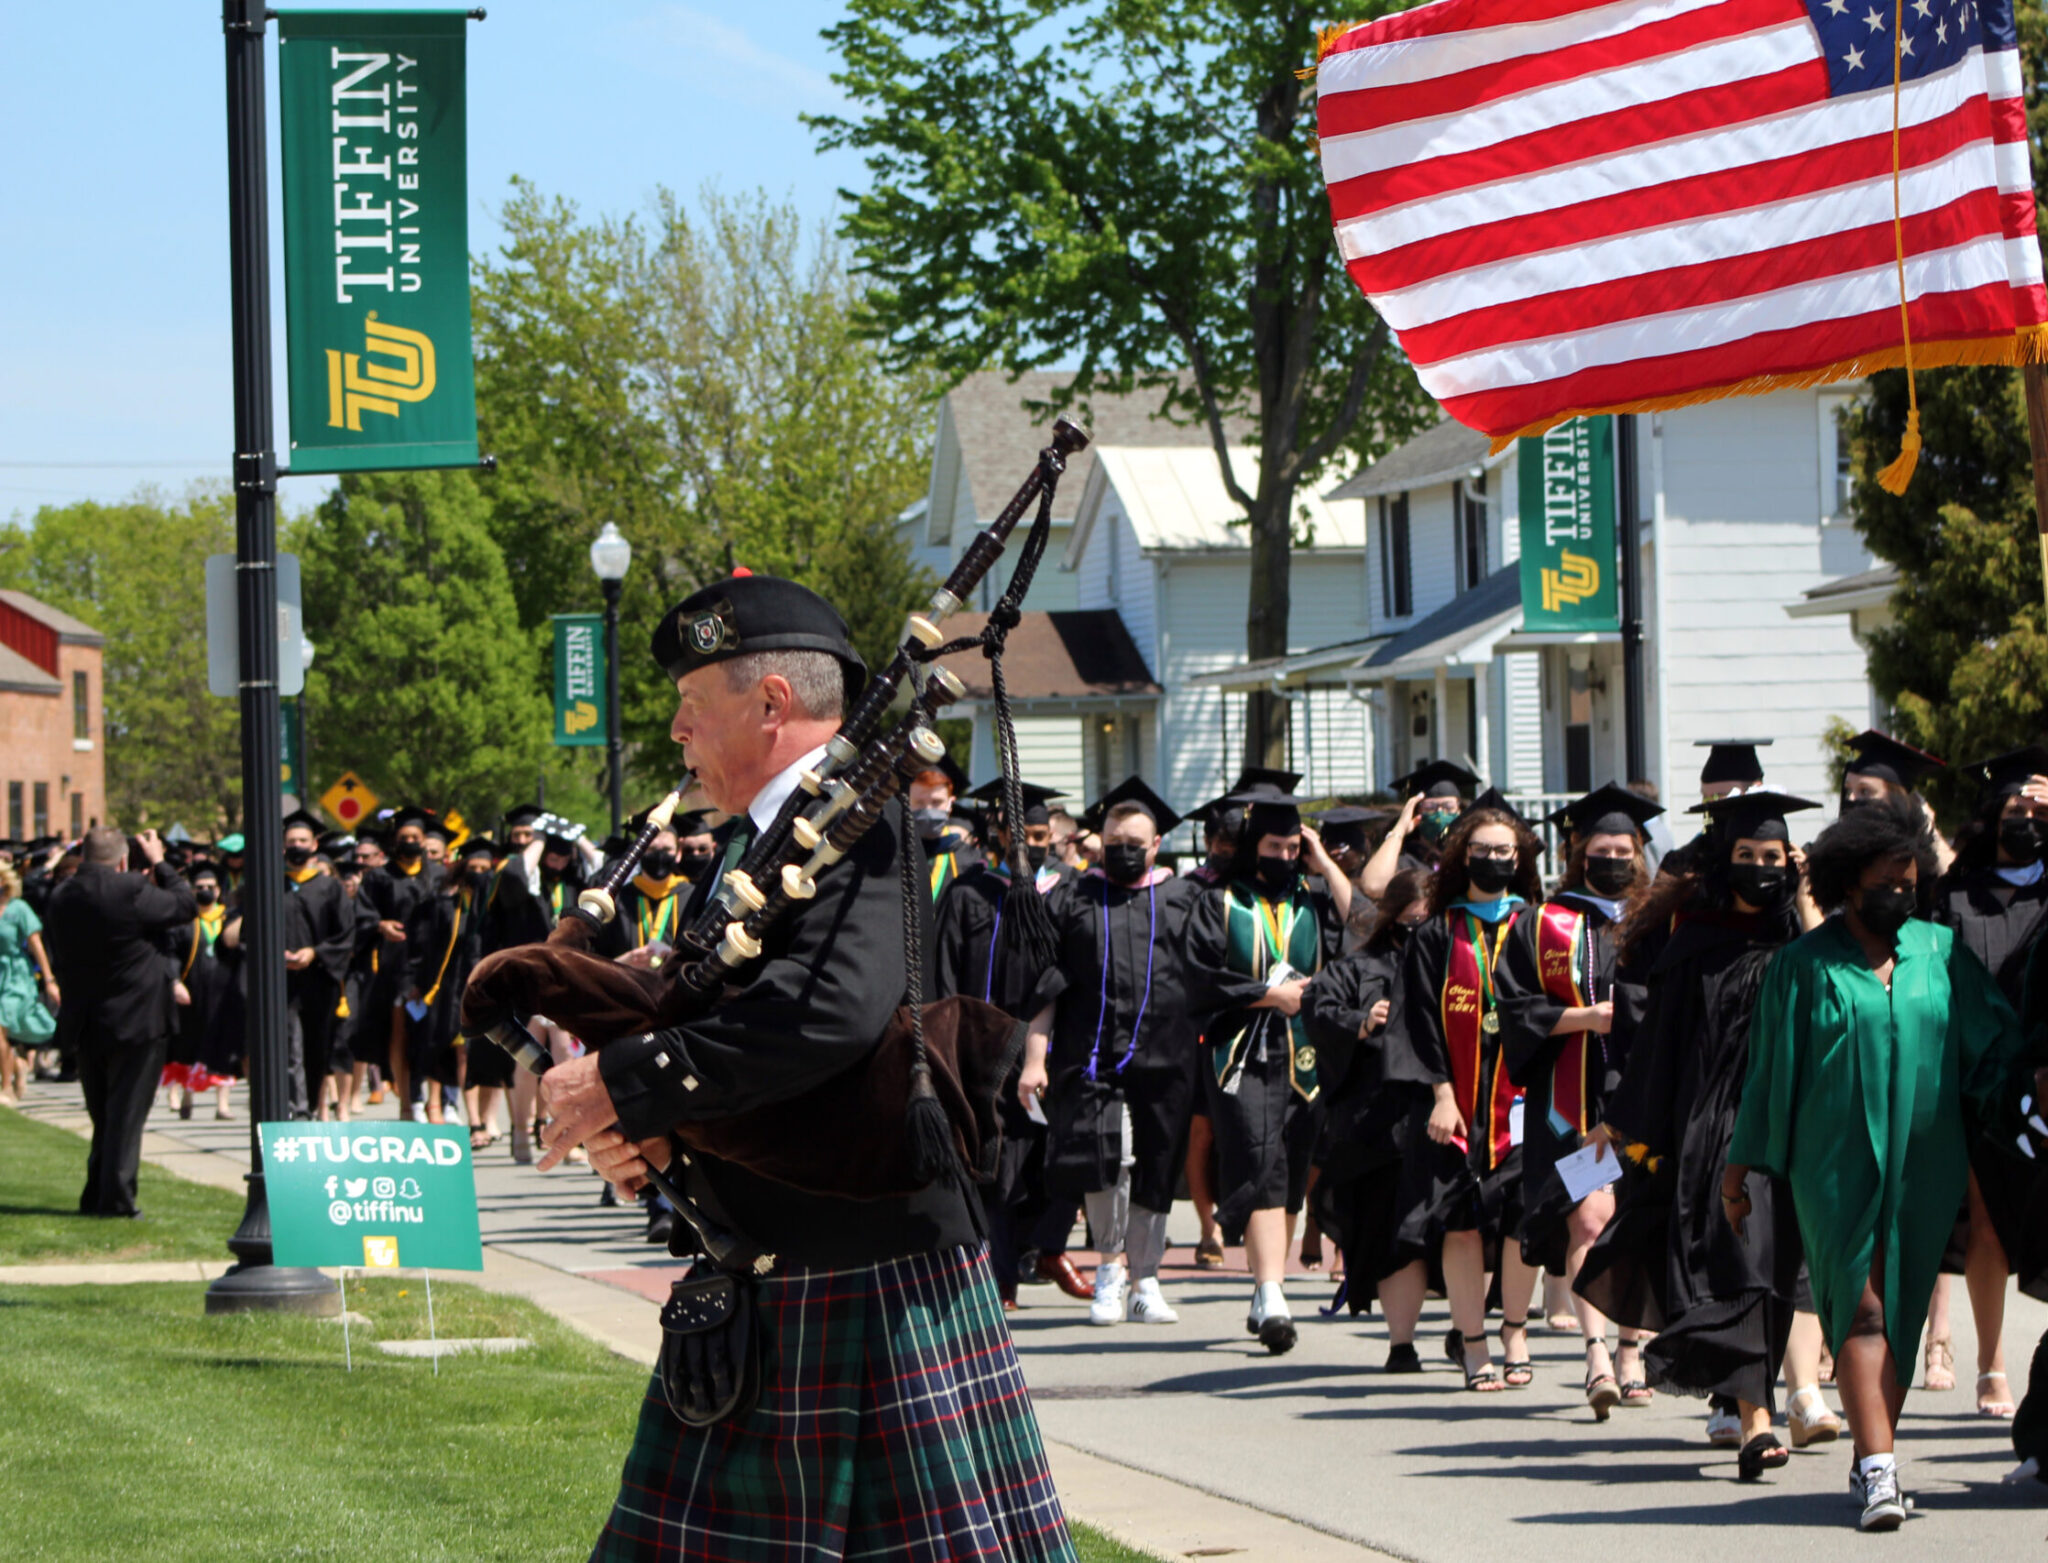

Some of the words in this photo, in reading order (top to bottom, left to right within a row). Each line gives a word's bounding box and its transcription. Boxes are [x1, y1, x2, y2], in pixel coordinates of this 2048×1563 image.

[331, 46, 394, 304] TIFFIN
[397, 53, 422, 292] UNIVERSITY
[325, 316, 437, 432] TU
[566, 626, 586, 699] TIFFIN
[272, 1135, 463, 1166] #TUGRAD
[328, 1199, 424, 1226] @tiffinu
